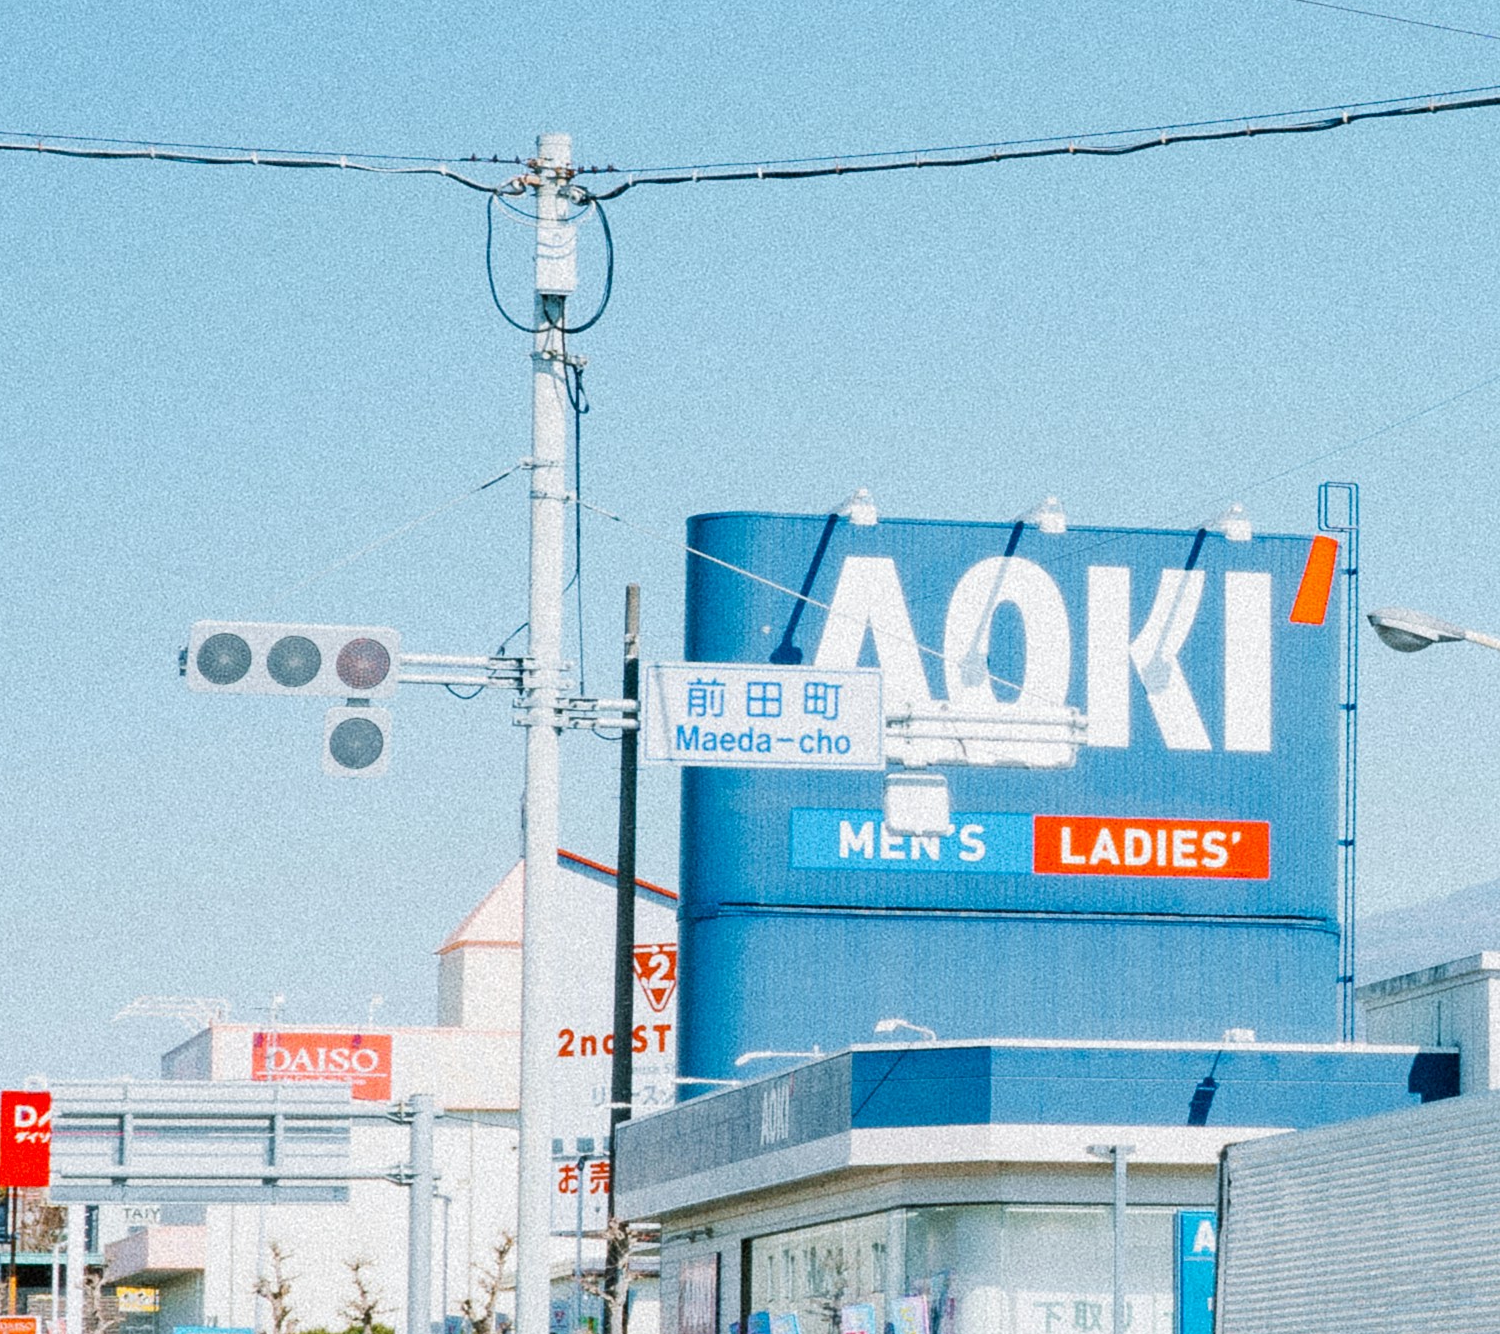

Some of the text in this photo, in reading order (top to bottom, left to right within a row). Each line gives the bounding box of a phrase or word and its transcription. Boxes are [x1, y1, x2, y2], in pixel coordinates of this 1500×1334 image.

[812, 555, 1273, 753] AOKI
[686, 677, 844, 718] 前田町
[674, 723, 853, 758] Maeda-cho
[839, 820, 987, 862] MEN'S
[1061, 826, 1241, 868] LADIES'
[266, 1047, 379, 1073] DAISO
[760, 1085, 790, 1146] AOKI
